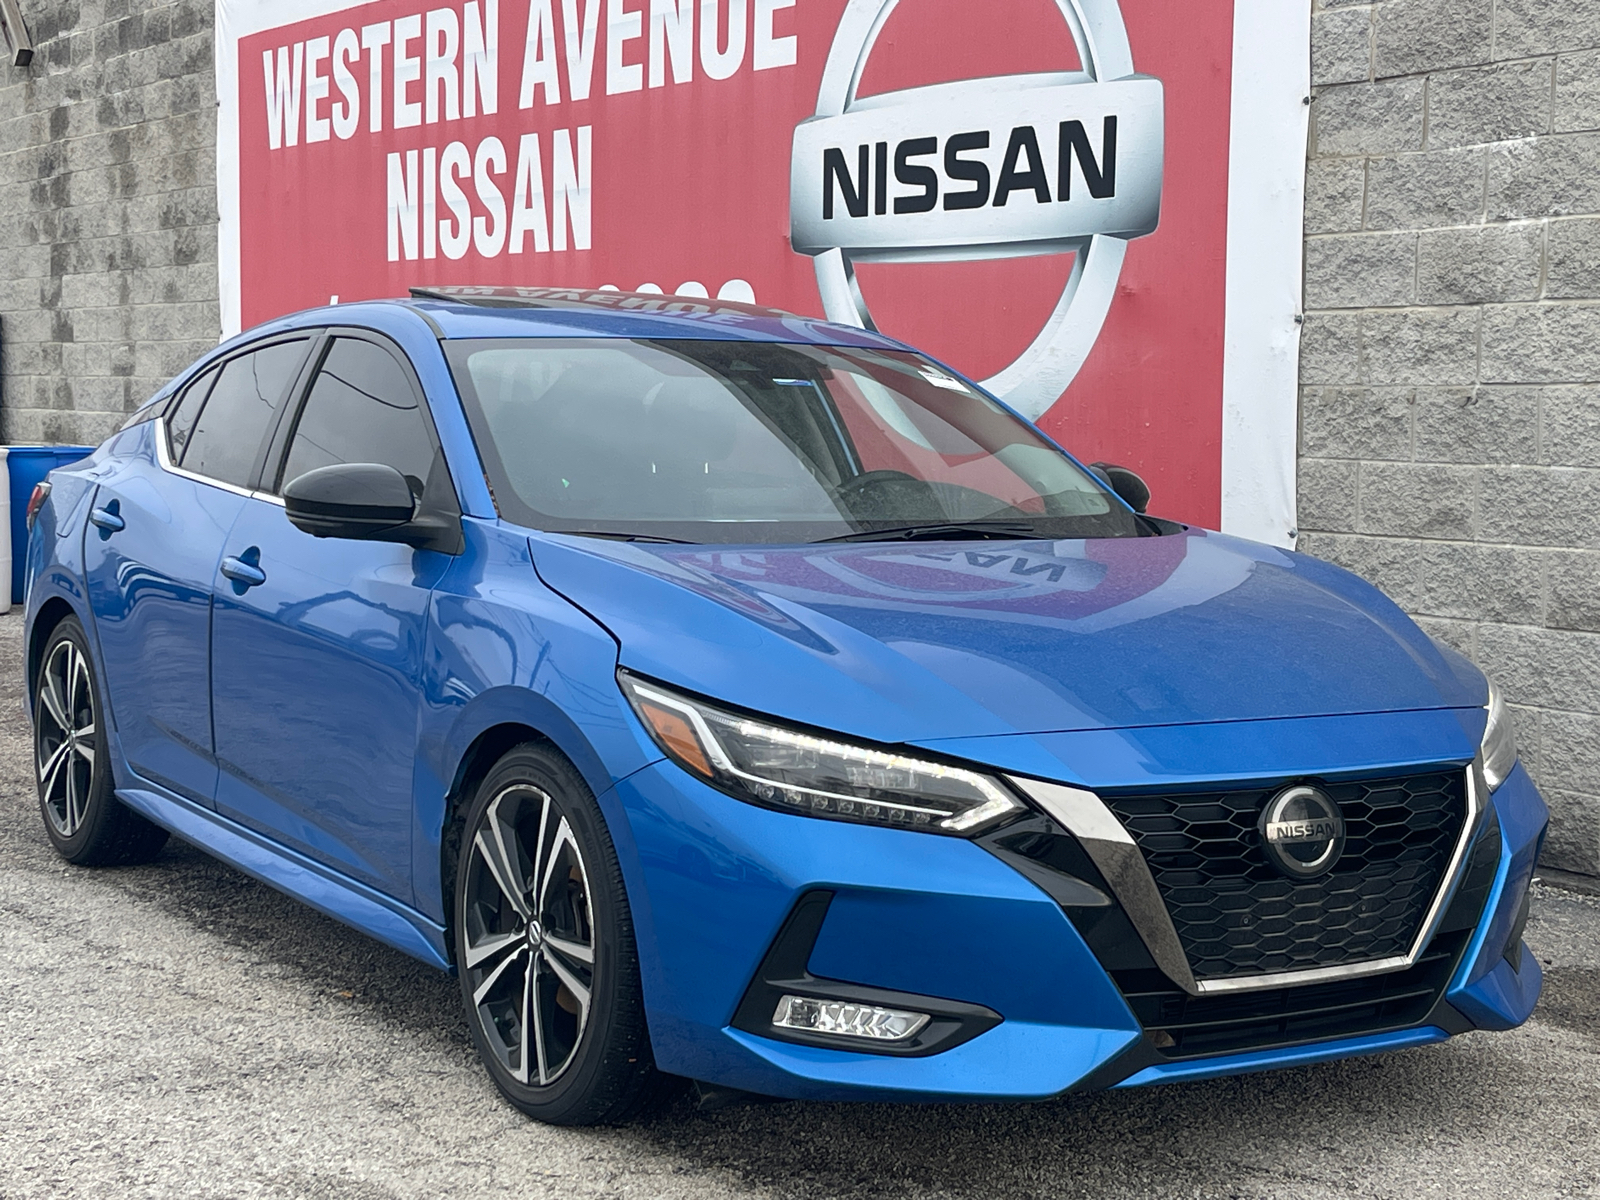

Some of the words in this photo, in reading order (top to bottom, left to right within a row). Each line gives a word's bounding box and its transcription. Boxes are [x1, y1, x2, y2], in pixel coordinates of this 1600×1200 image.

[263, 0, 499, 150] WESTERN
[386, 125, 592, 262] NISSAN
[822, 115, 1118, 220] NISSAN
[1276, 821, 1336, 839] NISSAN
